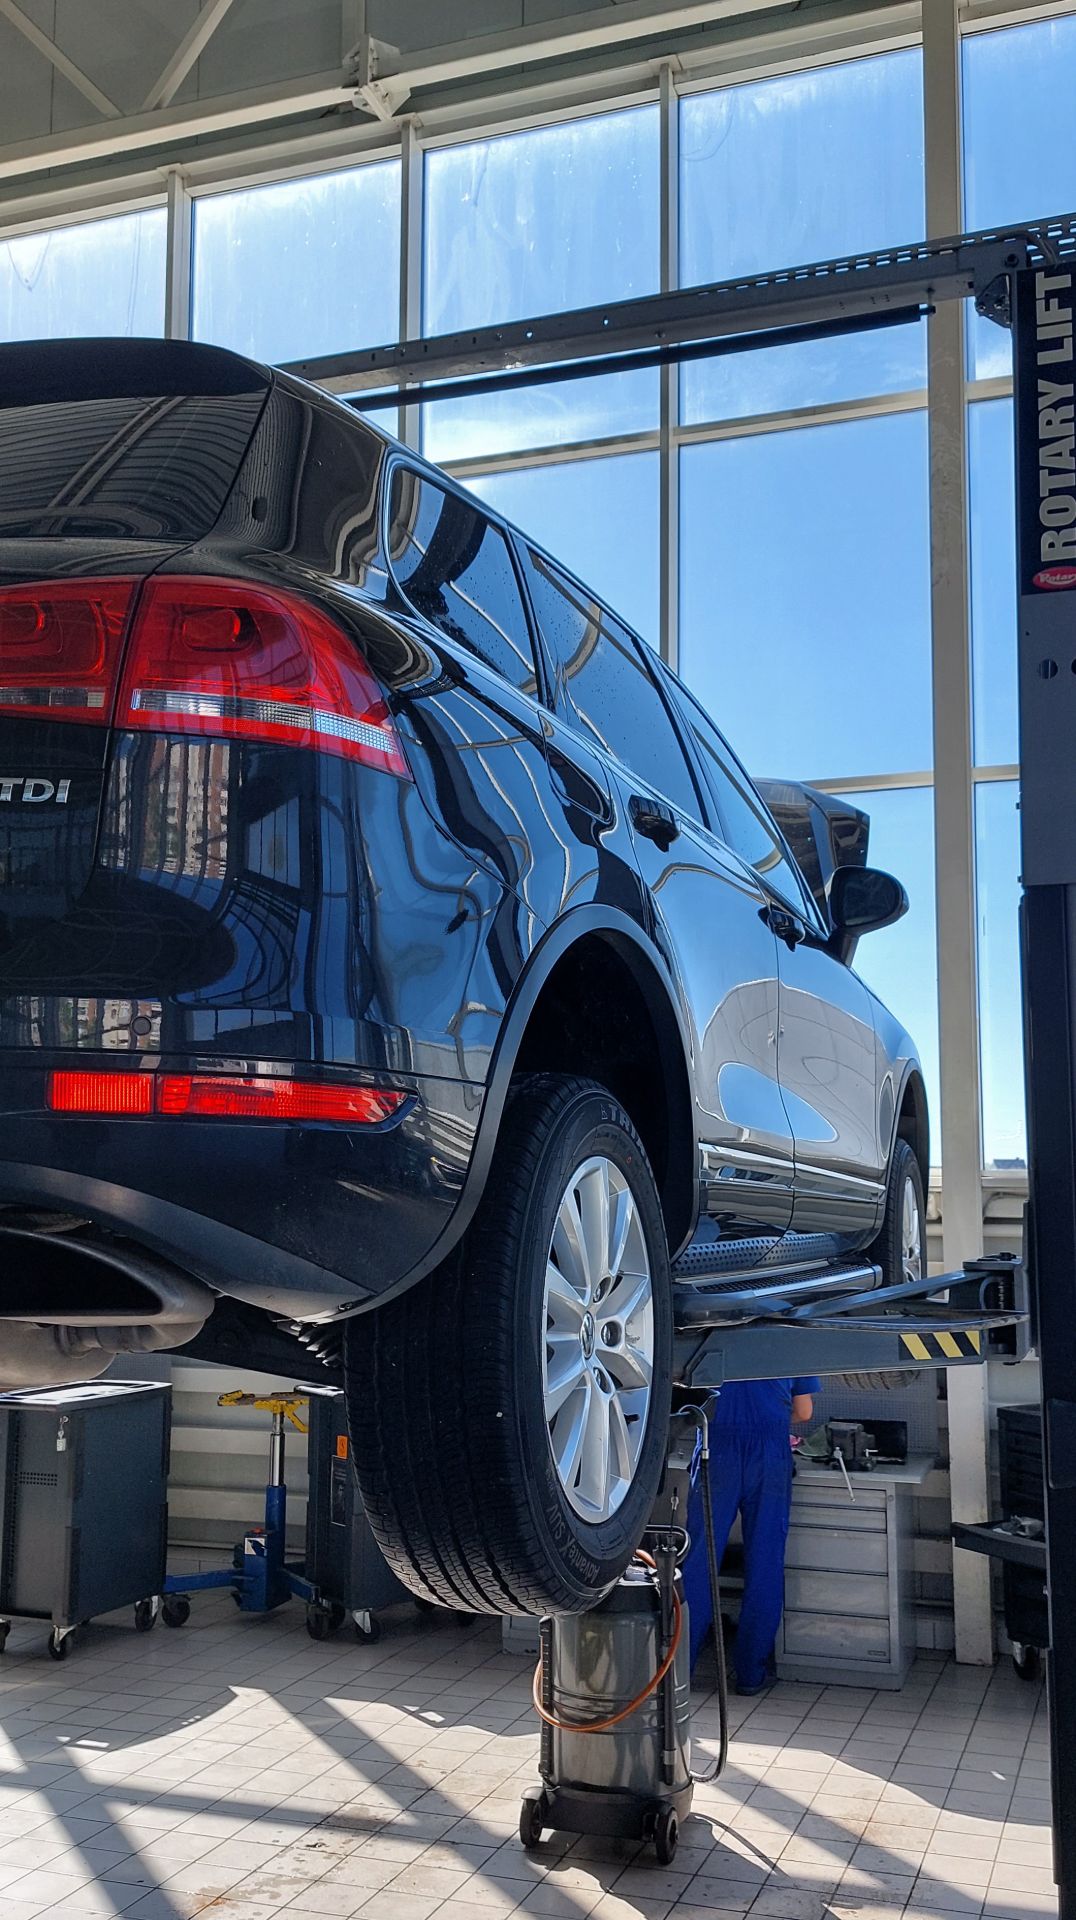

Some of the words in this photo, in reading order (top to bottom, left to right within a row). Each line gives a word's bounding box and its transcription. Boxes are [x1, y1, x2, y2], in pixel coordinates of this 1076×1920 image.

[1036, 272, 1074, 364] LIFT
[1038, 379, 1076, 562] ROTARY
[1039, 572, 1076, 585] Rotar
[0, 778, 71, 803] TDI
[546, 1504, 566, 1539] SUV
